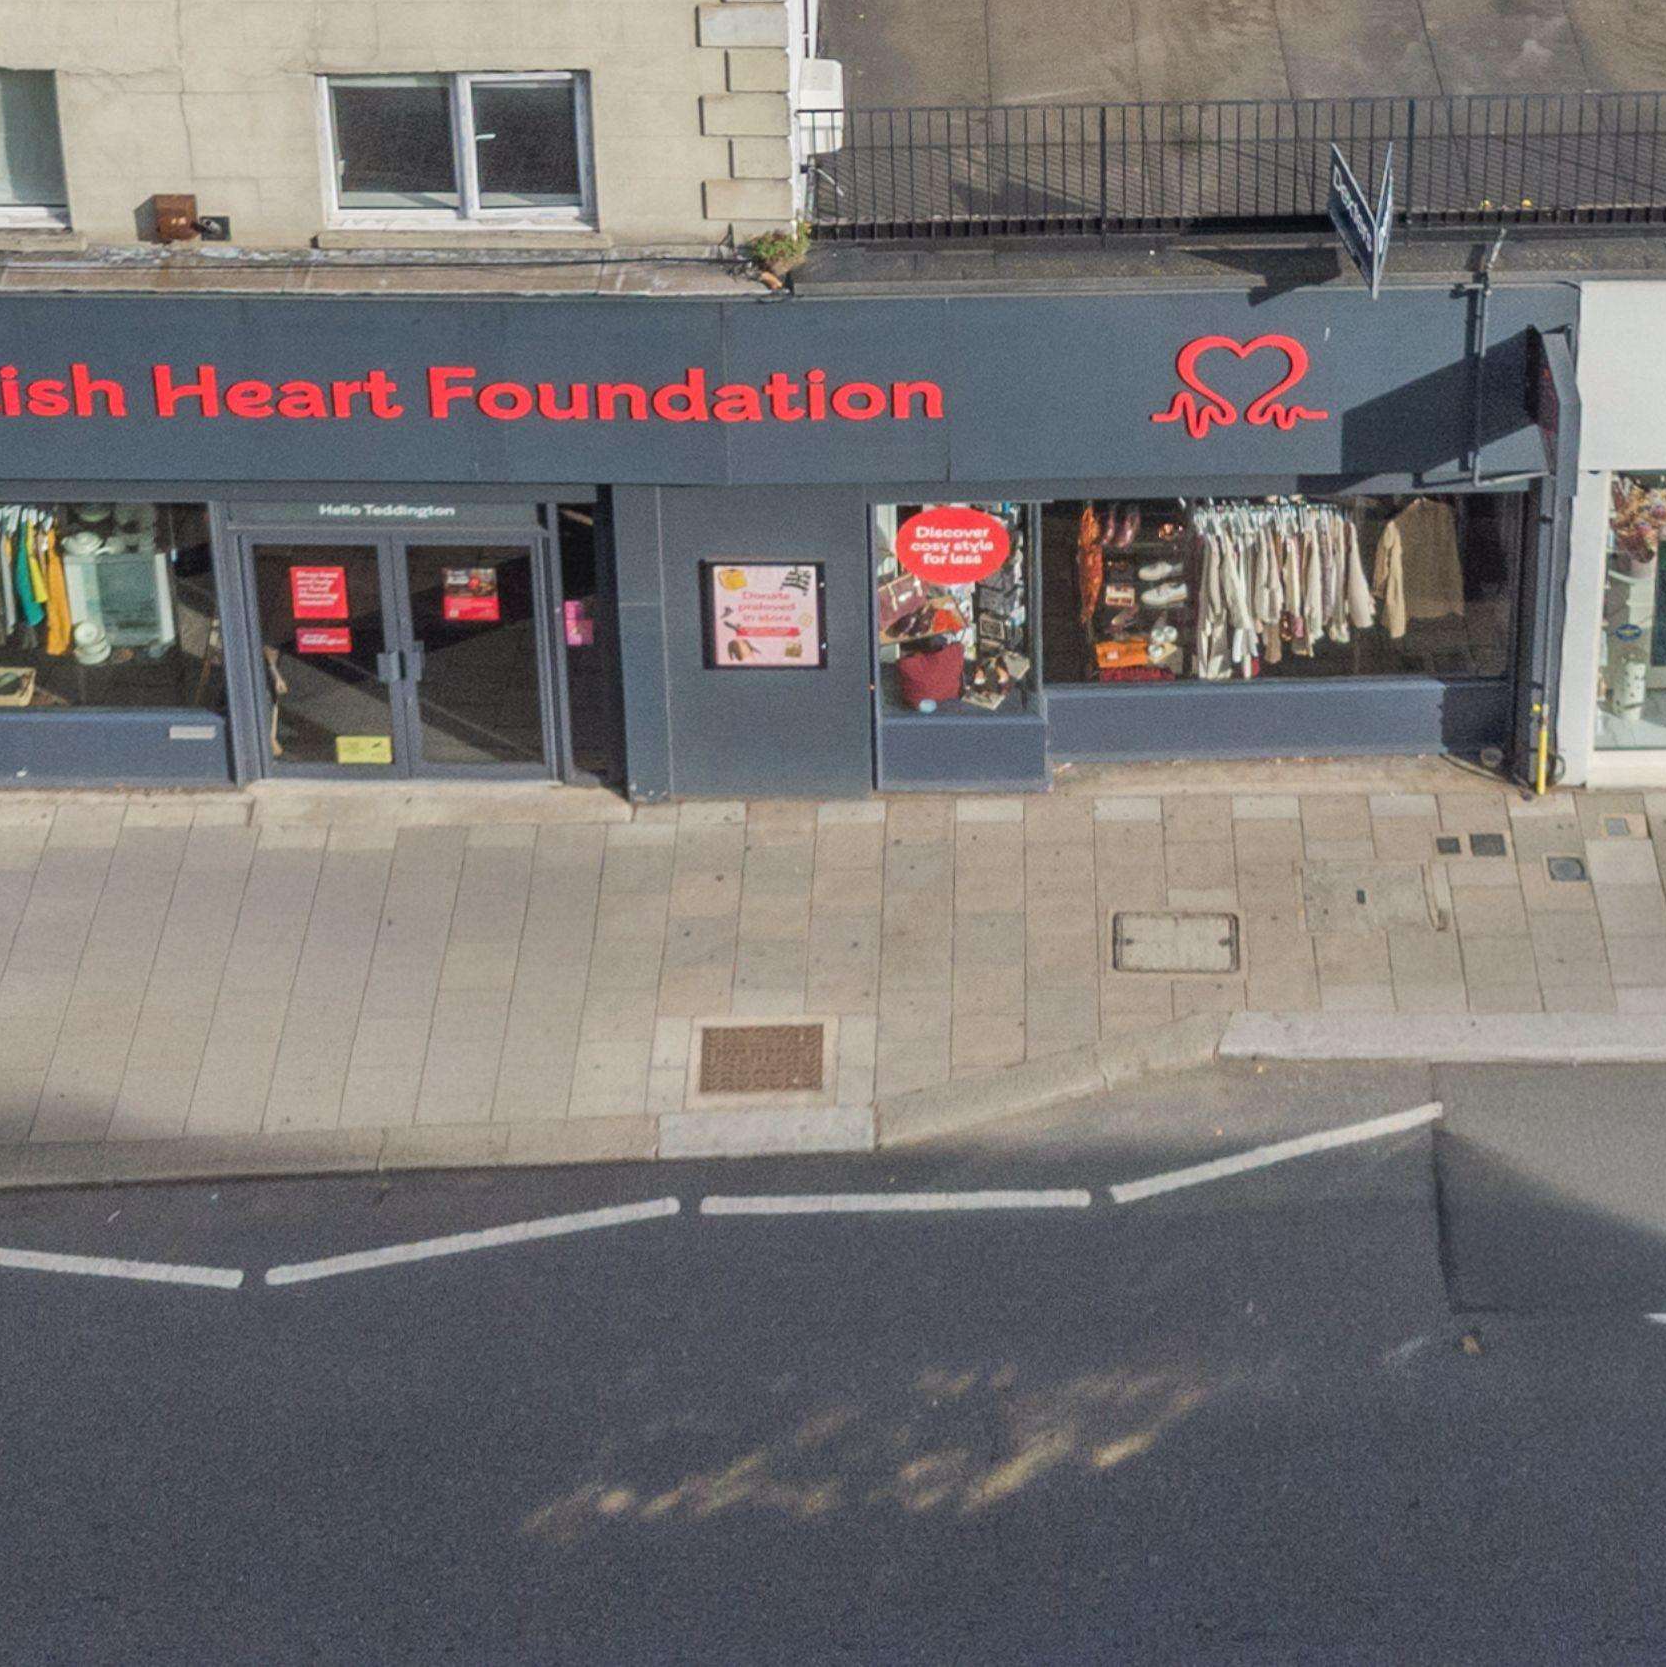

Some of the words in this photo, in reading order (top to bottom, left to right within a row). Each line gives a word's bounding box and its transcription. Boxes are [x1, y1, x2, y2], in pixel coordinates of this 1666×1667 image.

[153, 364, 404, 419] Heart
[427, 366, 944, 422] Foundation
[319, 504, 362, 517] Hello
[363, 504, 456, 519] Teddington
[915, 526, 990, 539] Discover
[953, 539, 994, 553] style
[922, 553, 947, 565] for
[950, 553, 983, 565] less
